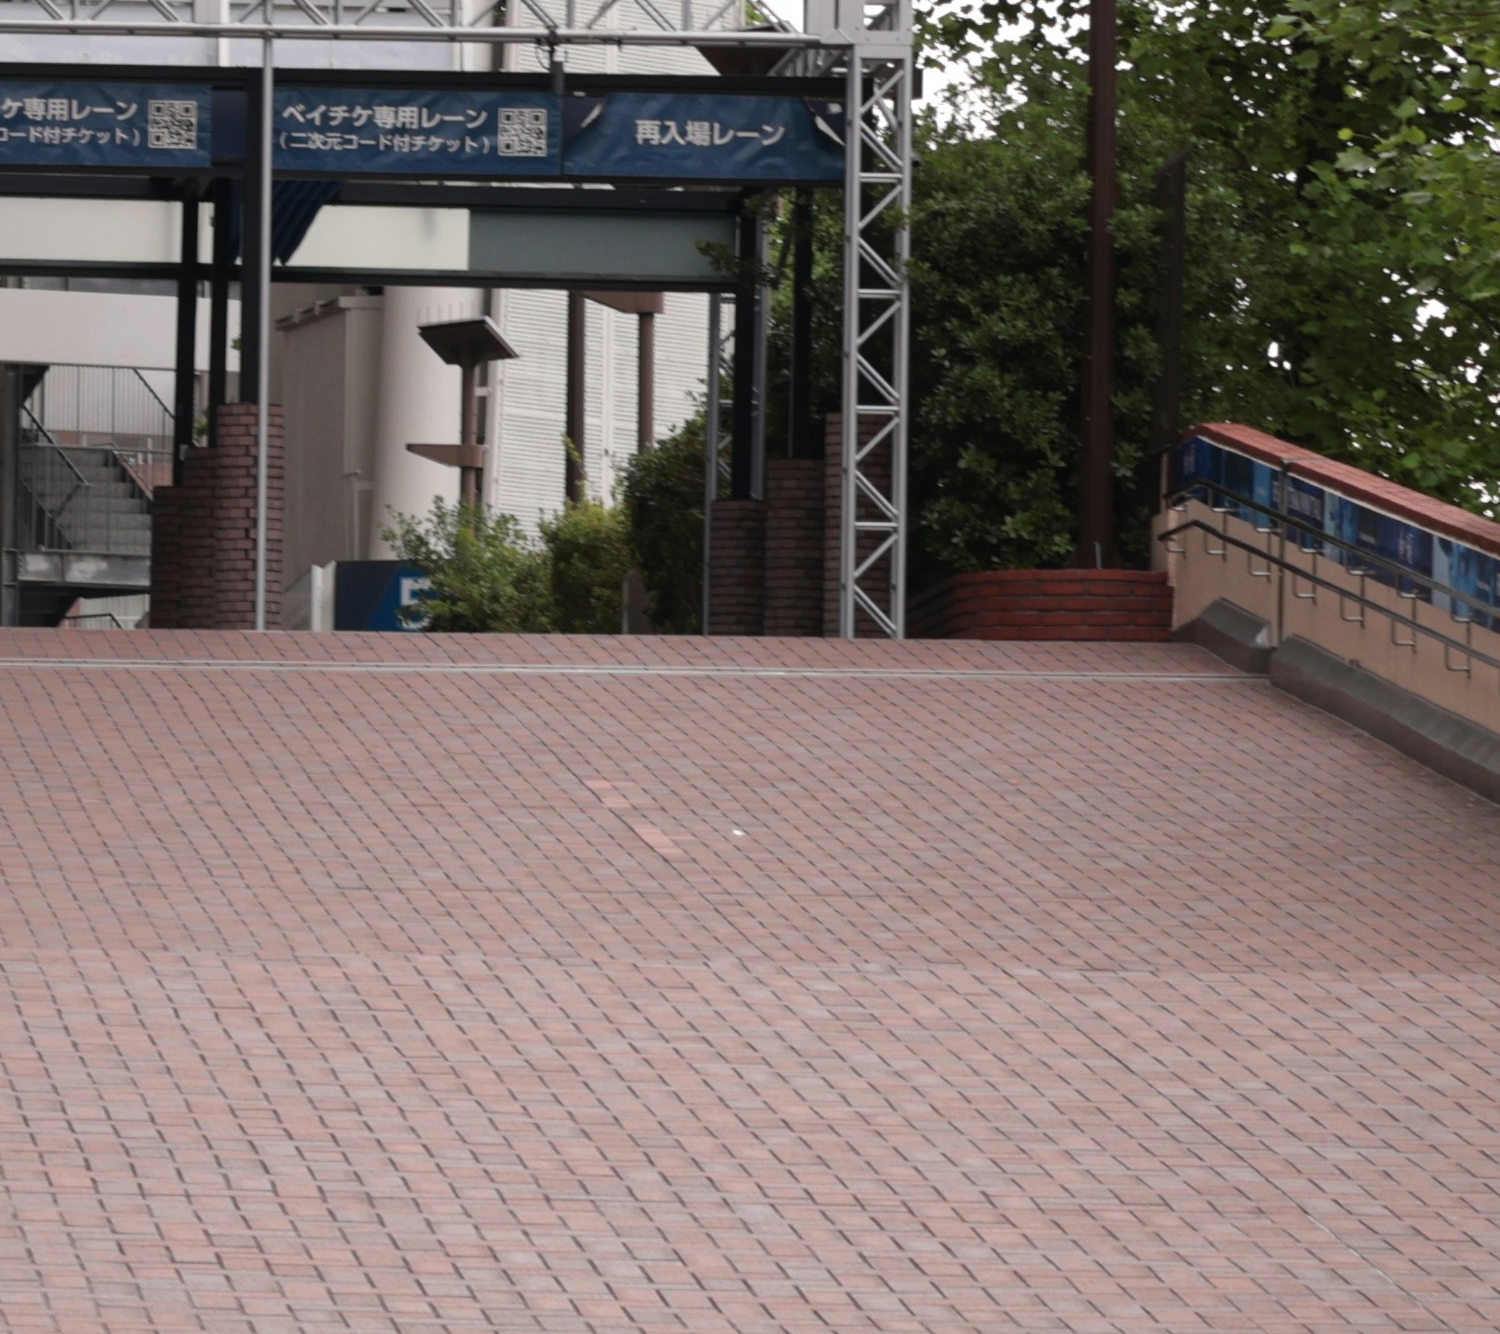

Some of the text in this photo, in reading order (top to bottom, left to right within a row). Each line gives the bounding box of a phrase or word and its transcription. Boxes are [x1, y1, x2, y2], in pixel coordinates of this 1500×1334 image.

[281, 103, 488, 130] ベイチケ専用レーン
[635, 117, 787, 148] 再入場レーン
